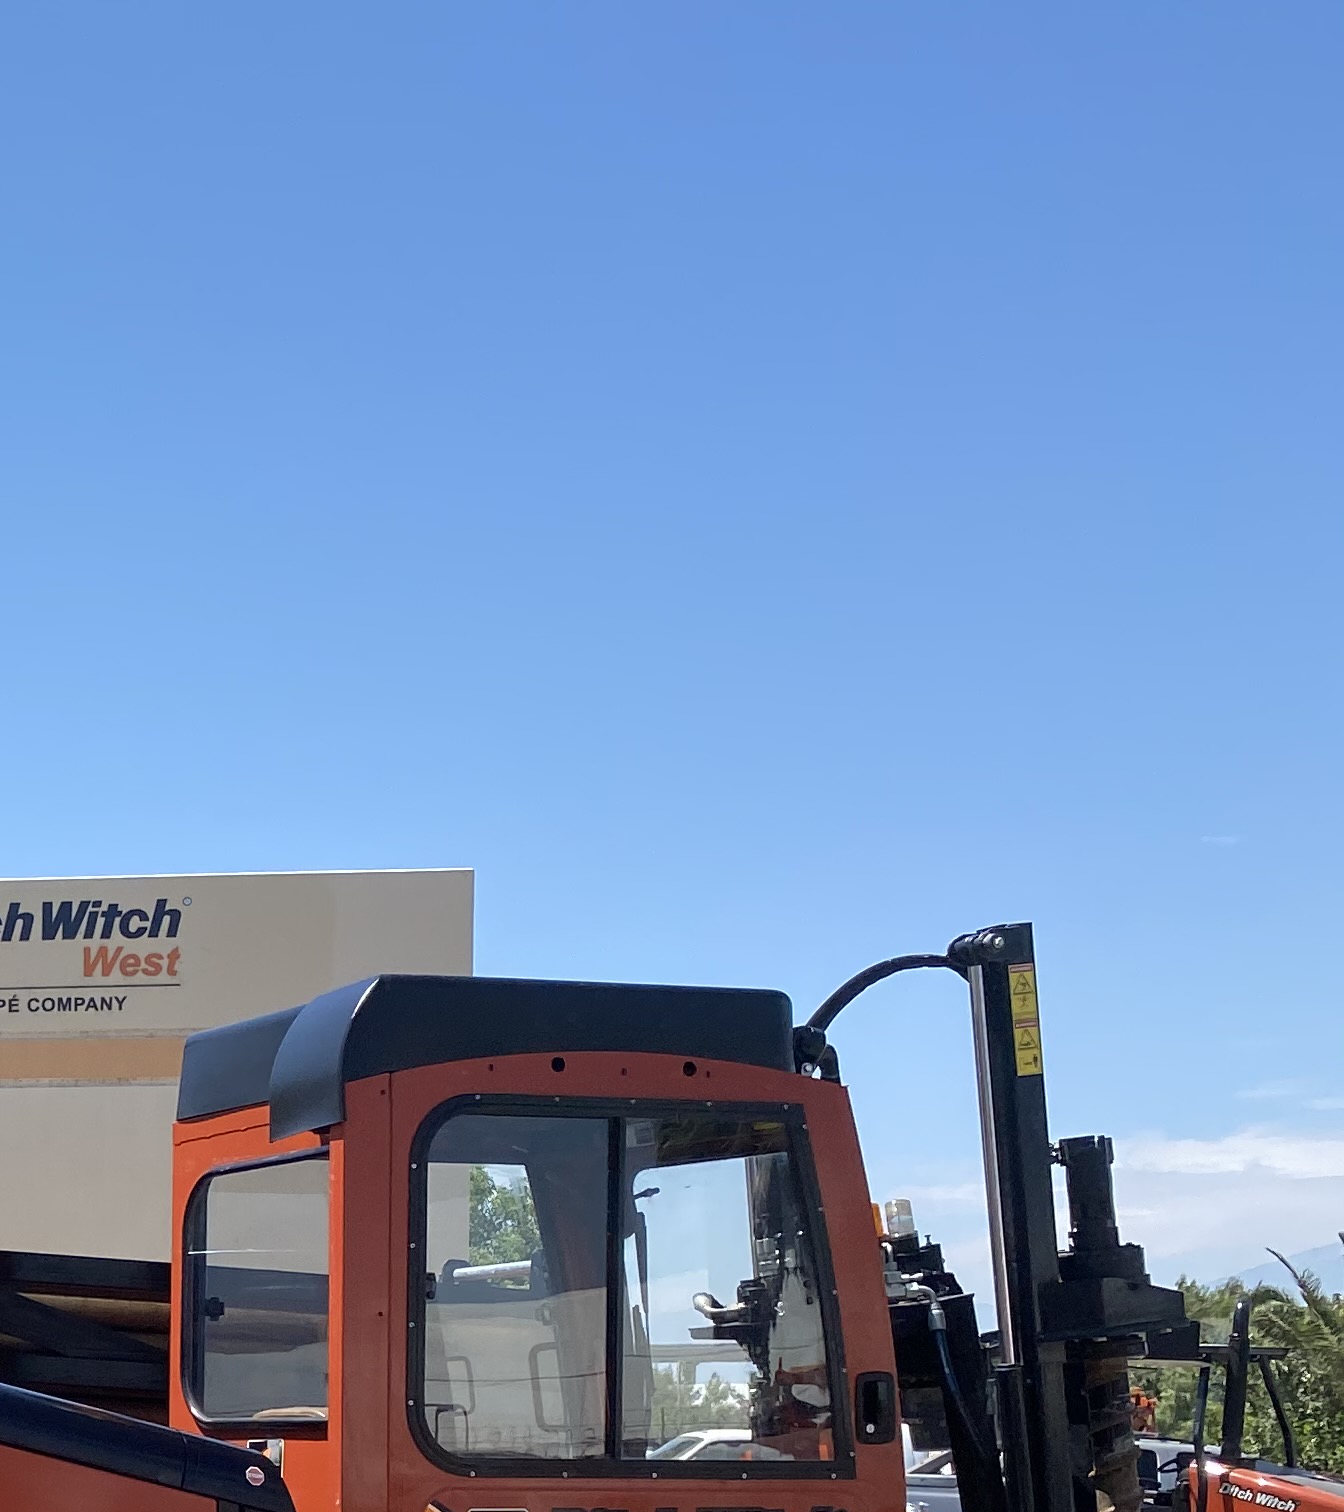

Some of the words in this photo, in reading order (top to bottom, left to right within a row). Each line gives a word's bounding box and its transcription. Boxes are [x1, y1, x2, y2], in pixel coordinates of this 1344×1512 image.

[41, 898, 183, 941] Witch
[82, 945, 182, 978] West
[27, 995, 129, 1013] COMPANY
[1219, 1482, 1253, 1502] Ditch
[1255, 1491, 1296, 1512] Witch
